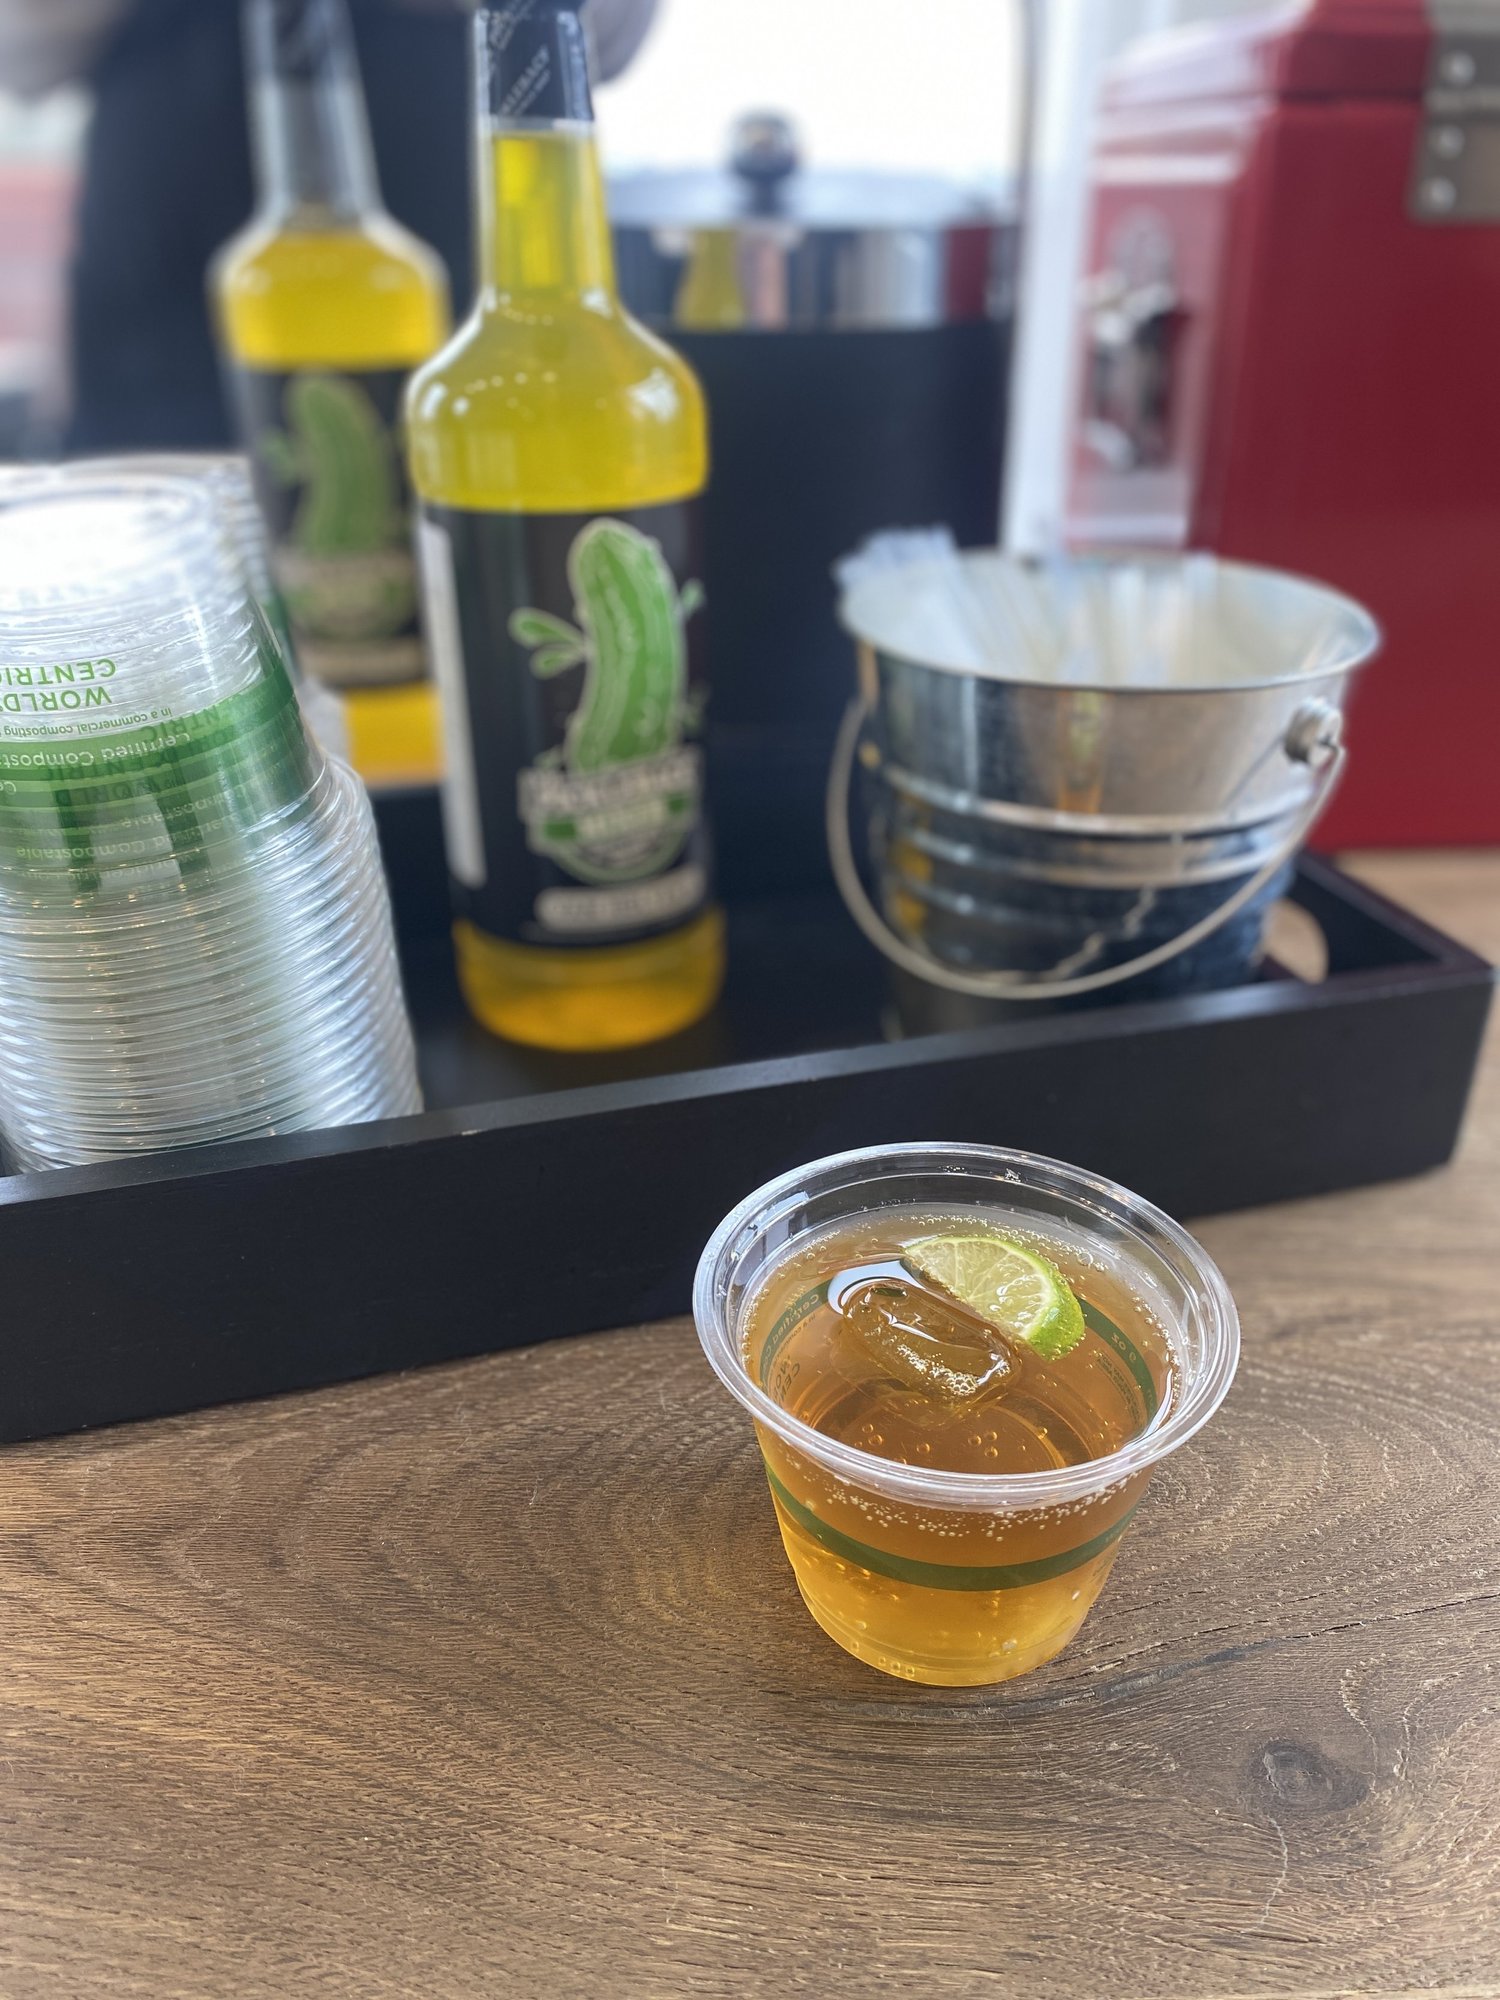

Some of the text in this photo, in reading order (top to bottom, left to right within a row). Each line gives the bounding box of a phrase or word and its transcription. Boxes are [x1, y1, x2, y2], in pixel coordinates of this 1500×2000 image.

[3, 708, 171, 738] in a commercial composting
[0, 752, 93, 770] Compost
